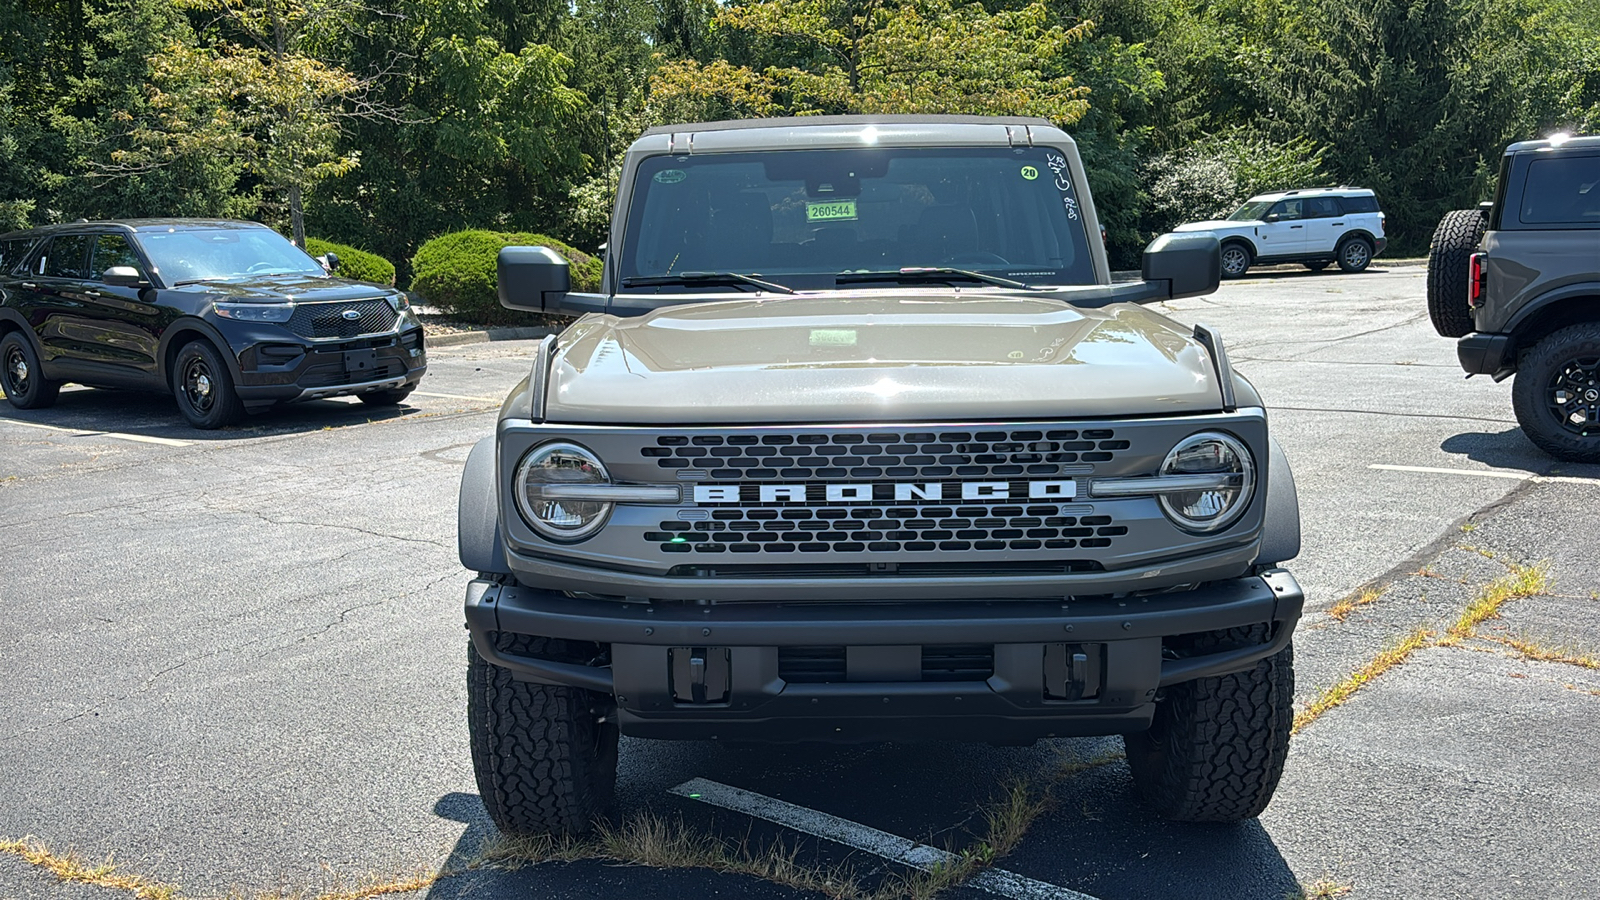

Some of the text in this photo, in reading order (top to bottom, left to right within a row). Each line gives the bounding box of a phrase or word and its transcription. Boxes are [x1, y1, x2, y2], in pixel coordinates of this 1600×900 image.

[1023, 167, 1036, 178] 20
[812, 205, 850, 218] 260544
[693, 480, 1077, 503] BRONCO
